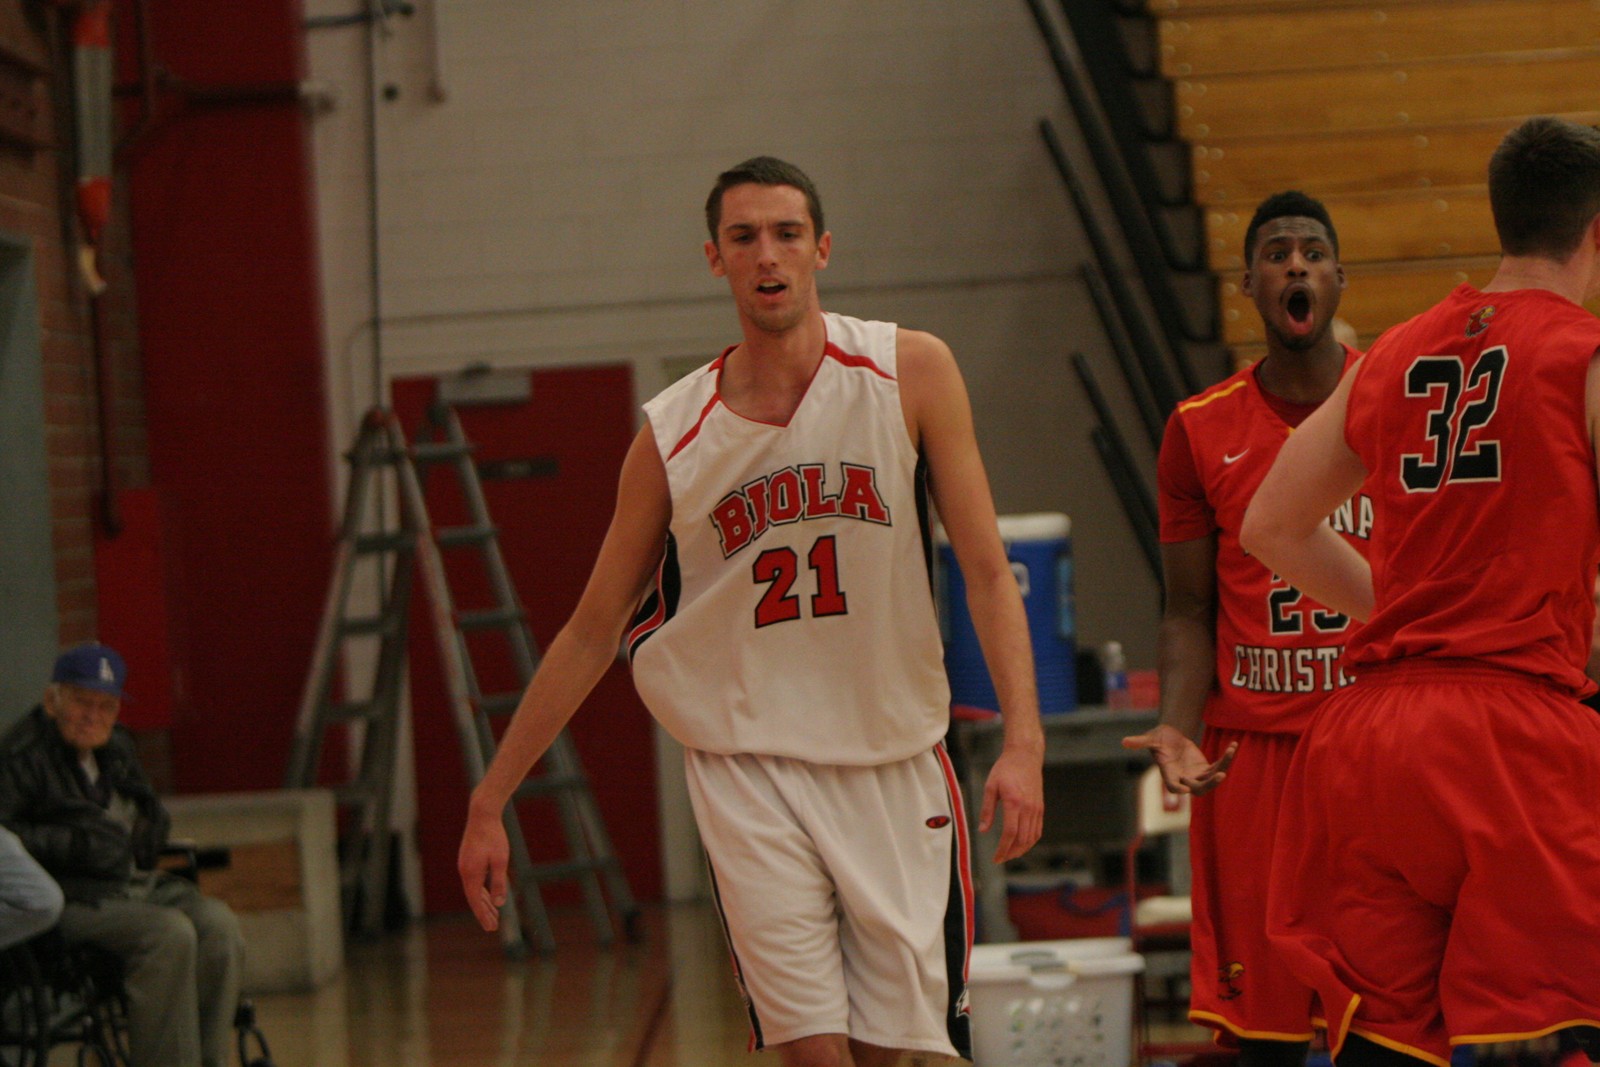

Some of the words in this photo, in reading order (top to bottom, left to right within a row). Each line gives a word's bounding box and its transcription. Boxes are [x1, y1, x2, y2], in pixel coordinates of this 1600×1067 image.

[1400, 344, 1509, 494] 32
[709, 461, 892, 560] BIOLA
[753, 534, 848, 629] 21
